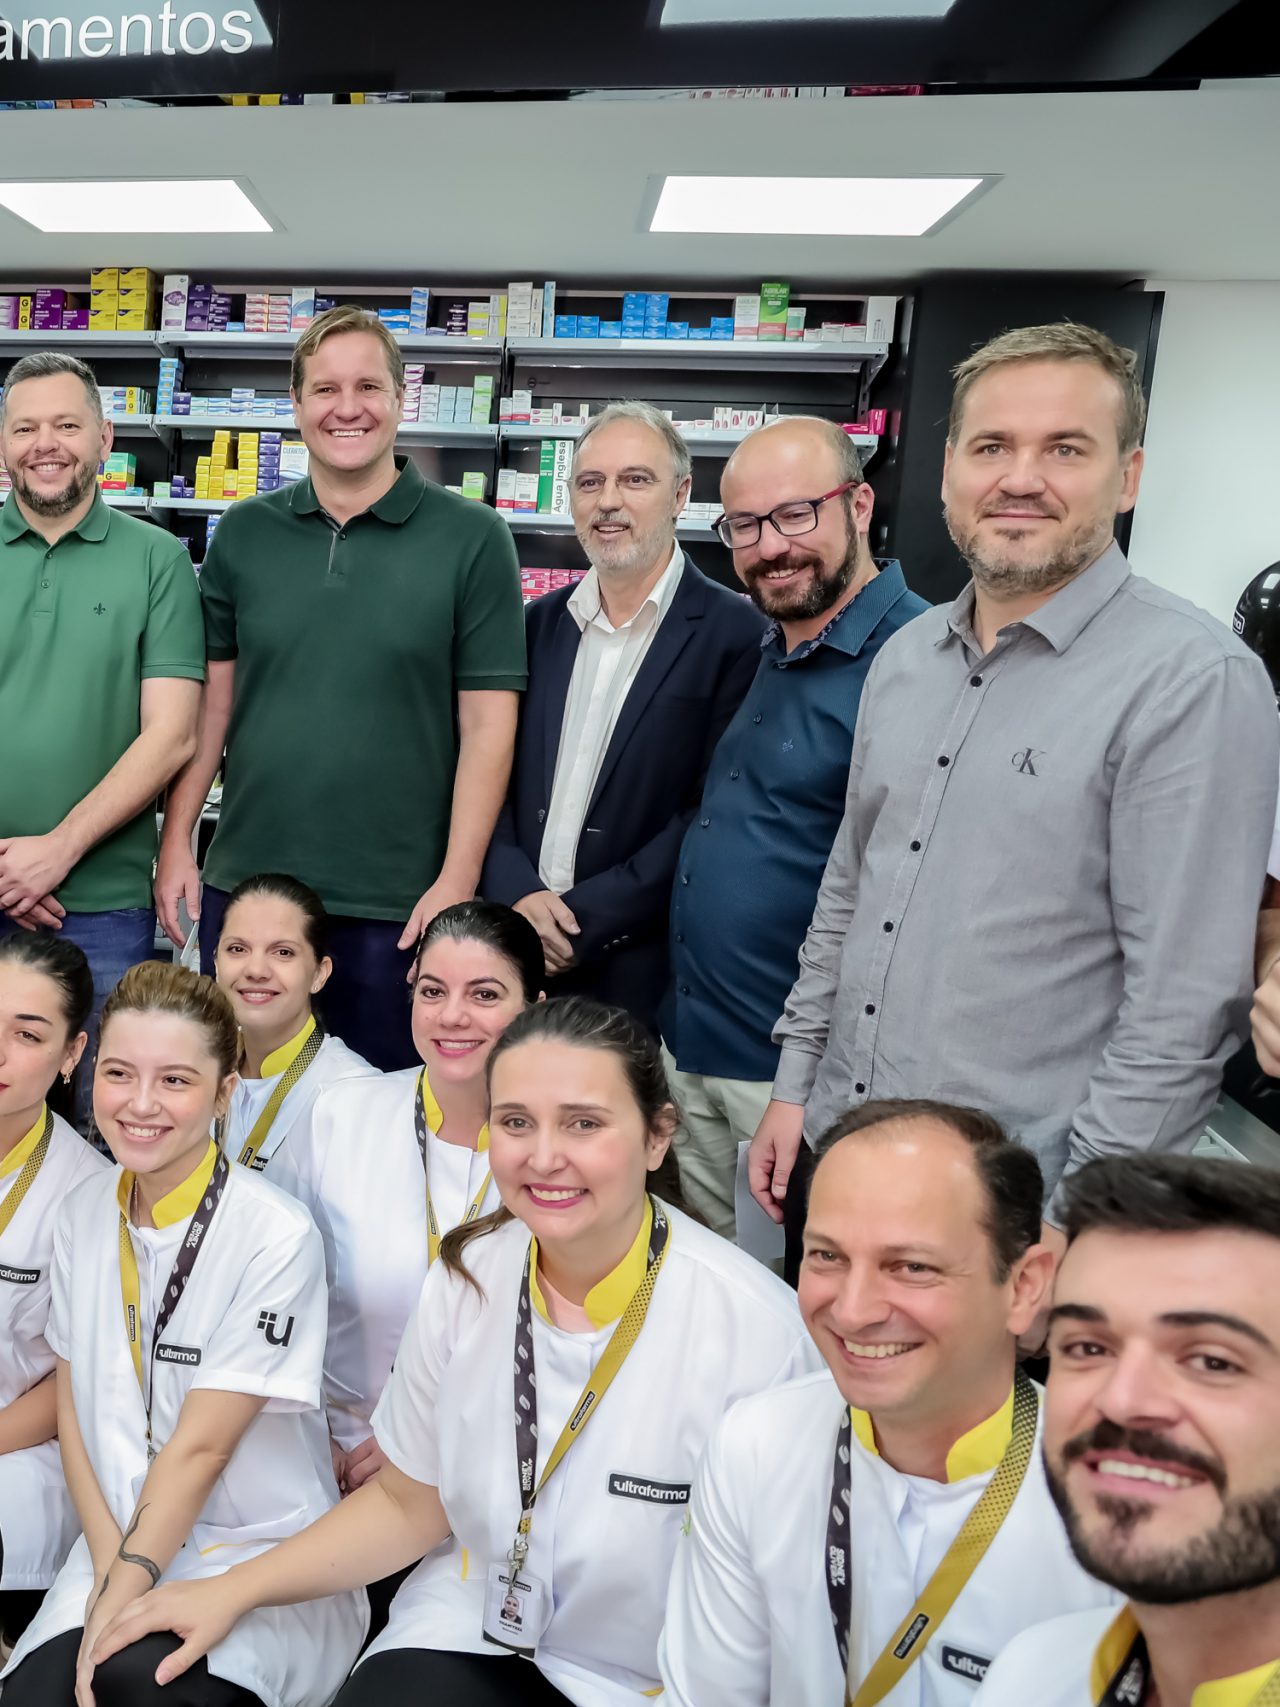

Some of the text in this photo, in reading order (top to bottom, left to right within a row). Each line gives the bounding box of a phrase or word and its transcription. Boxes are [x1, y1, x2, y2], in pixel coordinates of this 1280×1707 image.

[556, 441, 566, 481] Inglesa
[105, 472, 113, 480] G
[613, 1479, 687, 1500] ultrafarma
